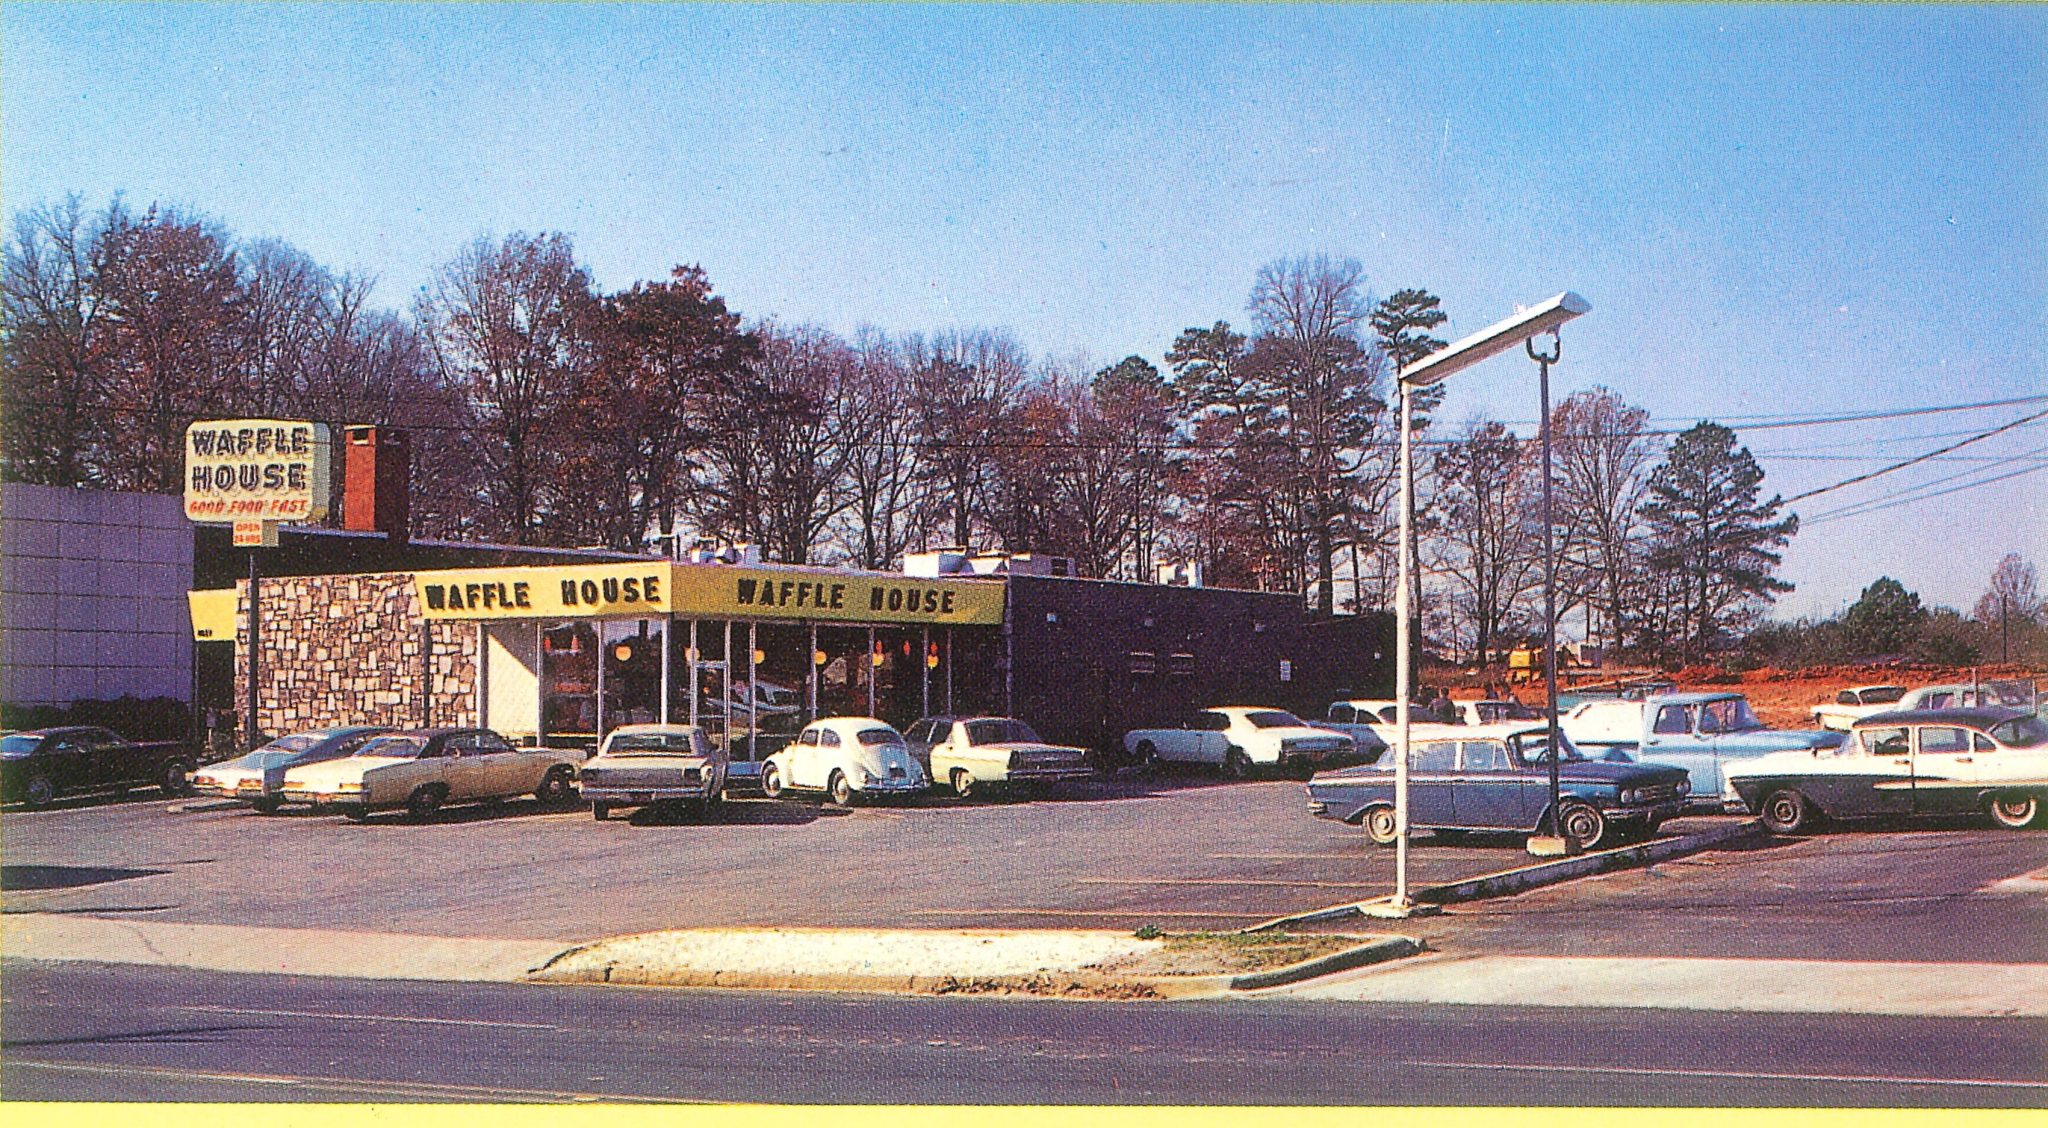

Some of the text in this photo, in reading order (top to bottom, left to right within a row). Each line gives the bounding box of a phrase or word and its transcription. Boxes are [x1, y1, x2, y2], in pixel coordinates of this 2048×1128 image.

[191, 427, 308, 456] WAFFLE
[191, 462, 307, 492] HOUSE
[189, 499, 308, 513] GOOD FOOD FAST
[235, 523, 260, 532] OPEN
[424, 575, 662, 611] WAFFLE HOUSE
[737, 578, 957, 614] WAFFLE HOUSE
